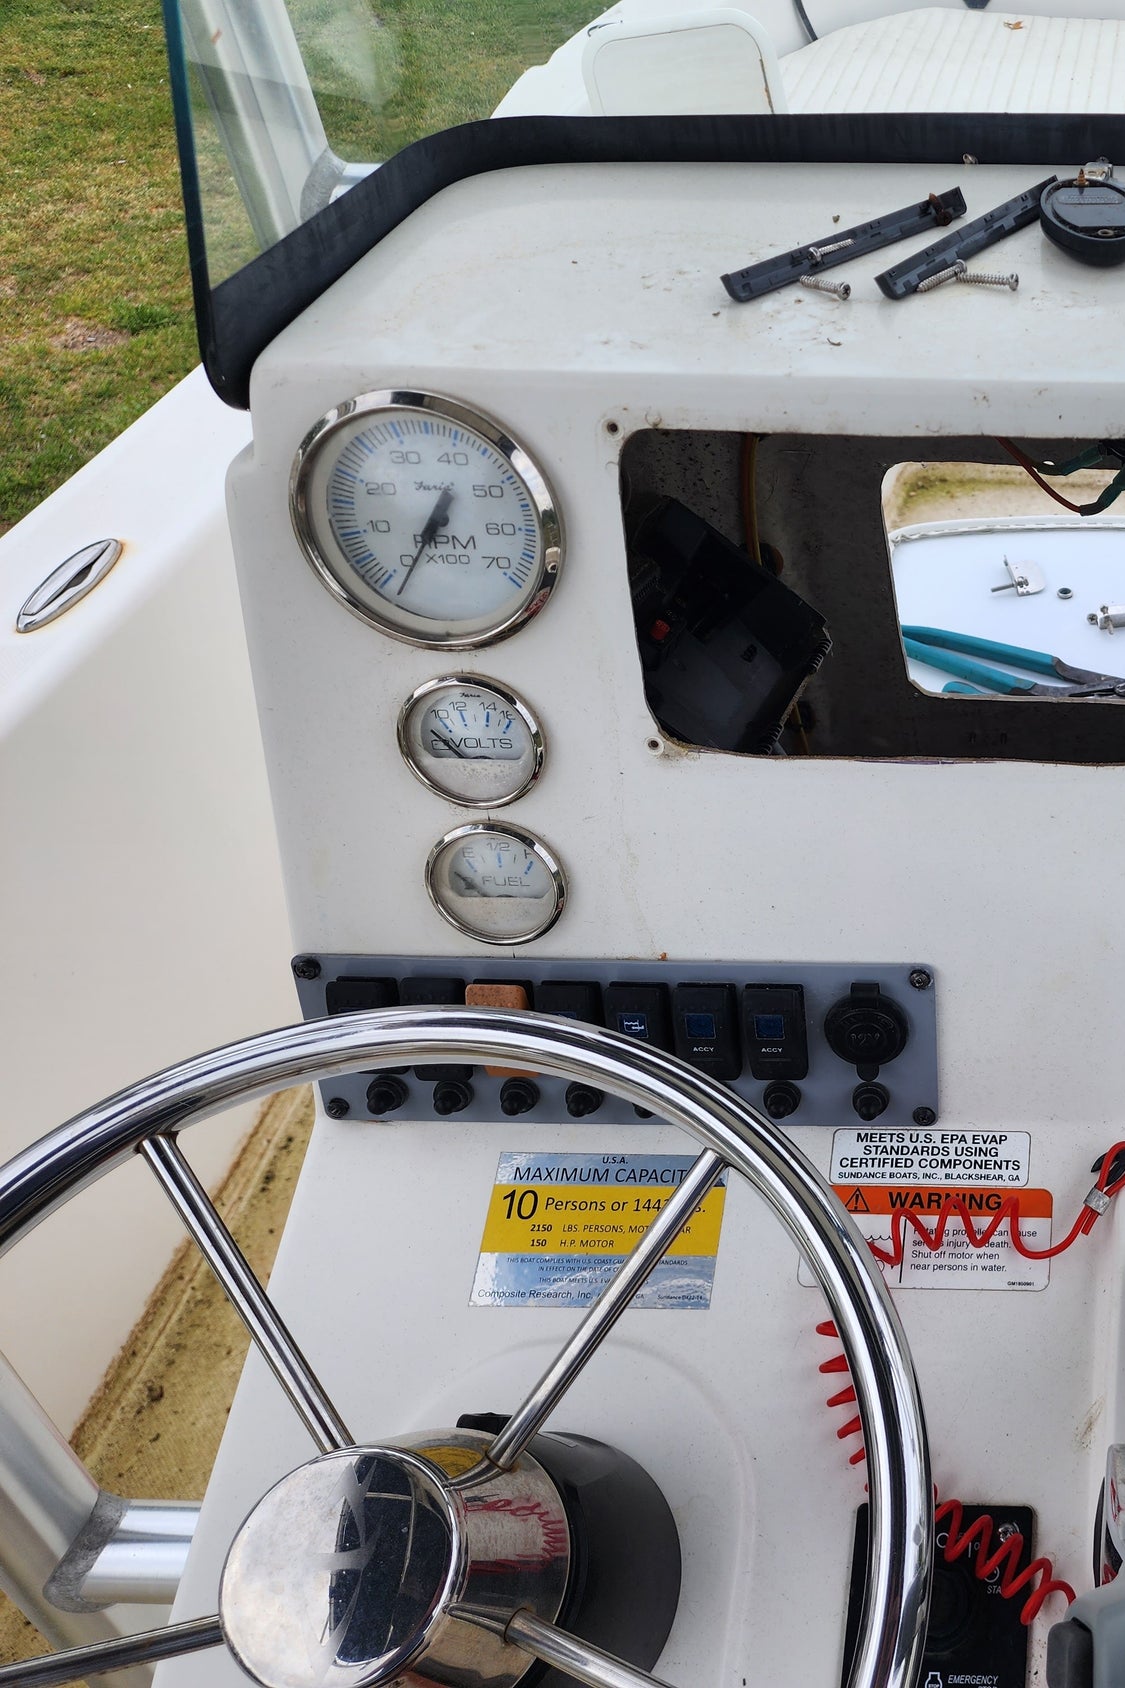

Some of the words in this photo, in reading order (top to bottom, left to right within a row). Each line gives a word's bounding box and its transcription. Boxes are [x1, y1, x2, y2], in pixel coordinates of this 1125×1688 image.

[390, 451, 421, 464] 30
[437, 452, 469, 466] 40
[365, 482, 396, 495] 20
[472, 484, 504, 498] 50
[367, 520, 391, 533] 10
[485, 522, 516, 536] 60
[413, 534, 476, 549] RPM
[400, 554, 415, 567] 0
[481, 556, 511, 569] 70
[449, 701, 467, 711] 12
[479, 702, 497, 711] 14
[430, 709, 449, 719] 10
[450, 737, 513, 749] VOLTS
[462, 847, 474, 858] E
[486, 842, 510, 852] 1/2
[482, 876, 531, 887] FUEL
[856, 1133, 905, 1143] MEETS
[909, 1133, 936, 1144] U.S.
[940, 1134, 968, 1145] EPA
[971, 1134, 1008, 1145] EVAP
[863, 1145, 950, 1156] STANDARDS
[955, 1146, 999, 1157] USING
[602, 1156, 629, 1164] U.S.A.
[839, 1157, 914, 1168] CERTIFIED
[918, 1158, 1021, 1171] COMPONENTS
[513, 1167, 609, 1182] MAXIMUM
[615, 1168, 688, 1183] CAPACIT
[838, 1171, 887, 1179] SUNDANCE
[889, 1172, 920, 1180] BOATS,
[944, 1173, 1006, 1182] BLACKSHEAR,
[1008, 1174, 1021, 1182] GA
[502, 1189, 539, 1220] 10
[545, 1197, 606, 1211] Persons
[611, 1200, 628, 1211] or
[530, 1224, 553, 1232] 2150
[562, 1225, 580, 1233] LBS.
[583, 1225, 626, 1234] PERSONS,
[530, 1239, 547, 1247] 150
[560, 1239, 576, 1248] H.P.
[580, 1239, 614, 1248] MOTOR
[946, 1238, 970, 1249] injury
[911, 1250, 933, 1259] Shut
[934, 1250, 946, 1259] off
[948, 1251, 975, 1260] motor
[976, 1251, 1000, 1260] when
[932, 1264, 968, 1273] persons
[970, 1263, 978, 1271] in
[980, 1264, 1007, 1272] water.
[478, 1289, 526, 1300] Composite
[528, 1289, 574, 1300] Research,
[948, 1675, 998, 1685] EMERGENCY
